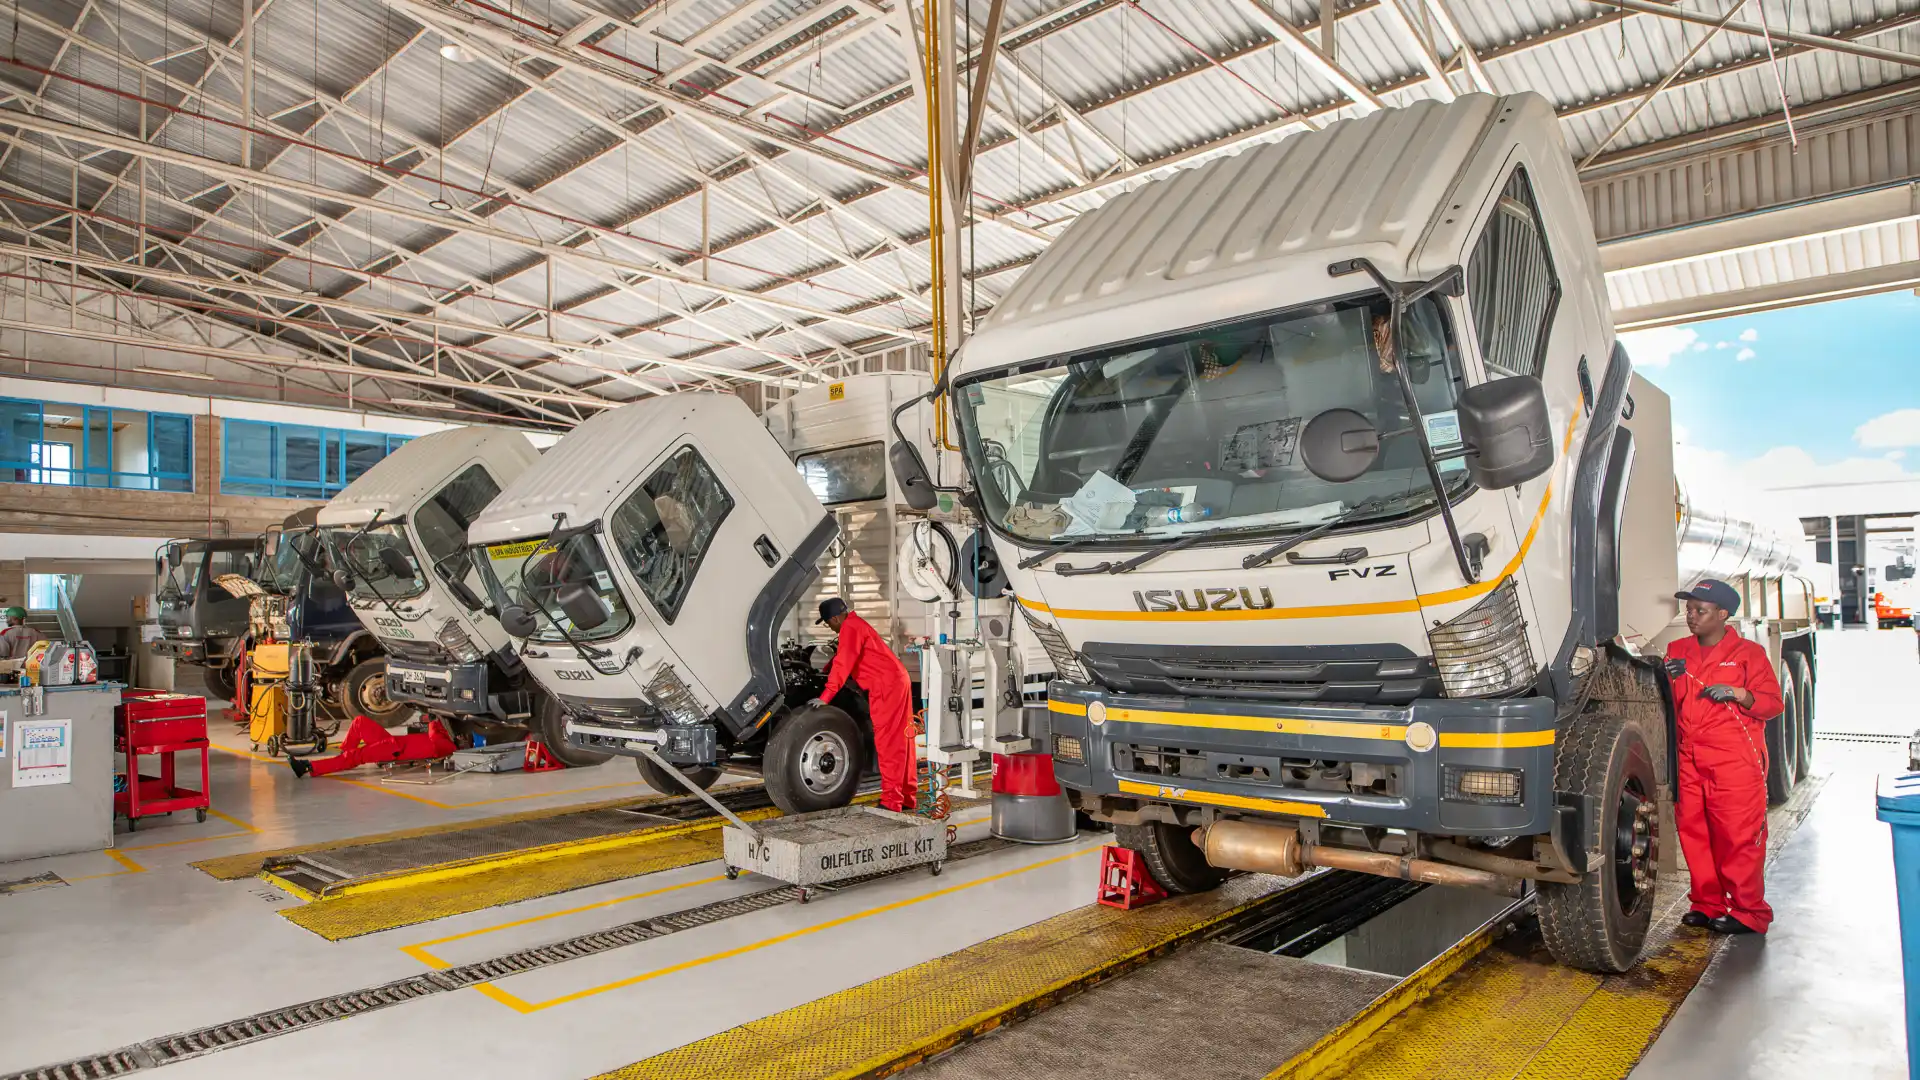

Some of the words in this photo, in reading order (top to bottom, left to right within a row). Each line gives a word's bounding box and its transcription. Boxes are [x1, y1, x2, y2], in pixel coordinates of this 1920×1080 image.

[830, 387, 843, 396] SPA
[505, 544, 534, 556] INDUSTRIES
[1328, 564, 1398, 582] FVZ
[1132, 586, 1276, 613] ISUZU
[554, 669, 595, 681] ISUZU
[820, 847, 875, 871] OILFILTER
[881, 842, 910, 861] SPILL
[914, 837, 935, 854] KIT
